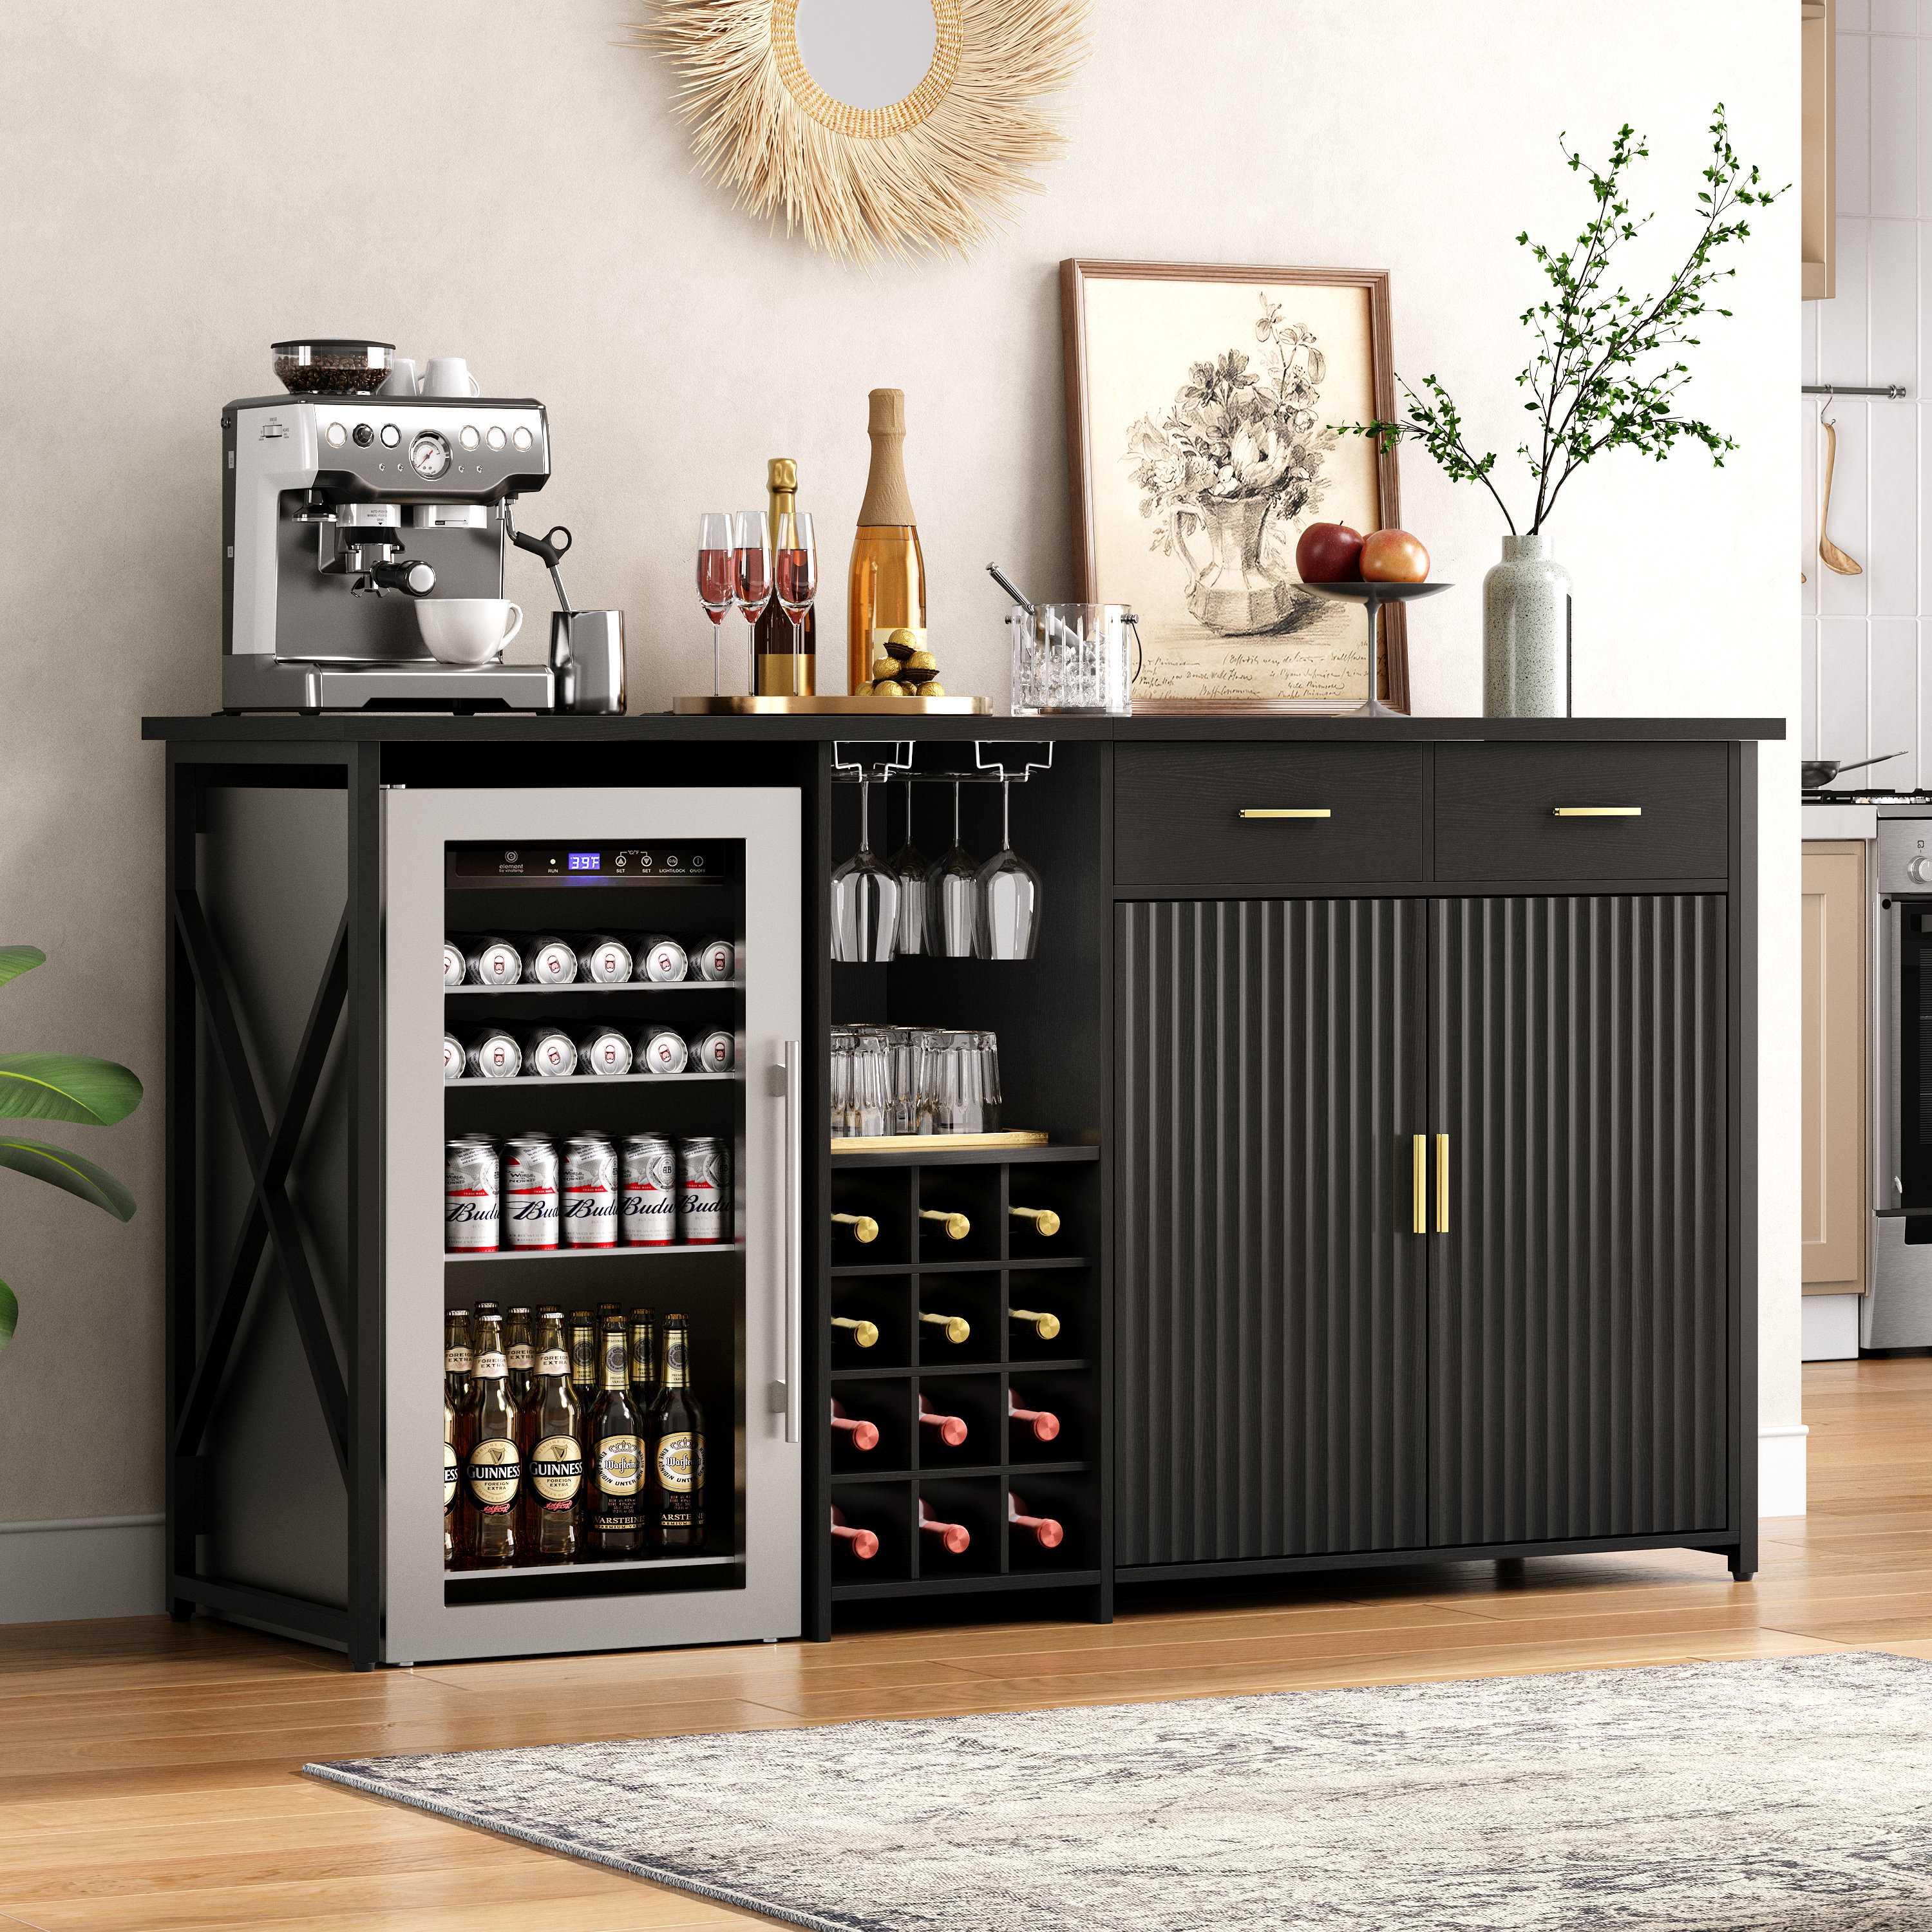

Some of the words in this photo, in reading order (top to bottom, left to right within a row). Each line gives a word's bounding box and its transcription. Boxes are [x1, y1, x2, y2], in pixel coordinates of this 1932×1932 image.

[537, 1440, 560, 1454] GENUINE
[659, 1448, 668, 1459] EINE
[598, 1451, 607, 1464] EINE
[444, 1468, 459, 1482] ESS
[466, 1465, 520, 1479] GUINNESS
[529, 1461, 583, 1475] GUINNESS
[596, 1465, 613, 1484] KÖNIGIN
[658, 1461, 675, 1481] KÖNIGIN
[659, 1512, 706, 1521] ARSTEINE
